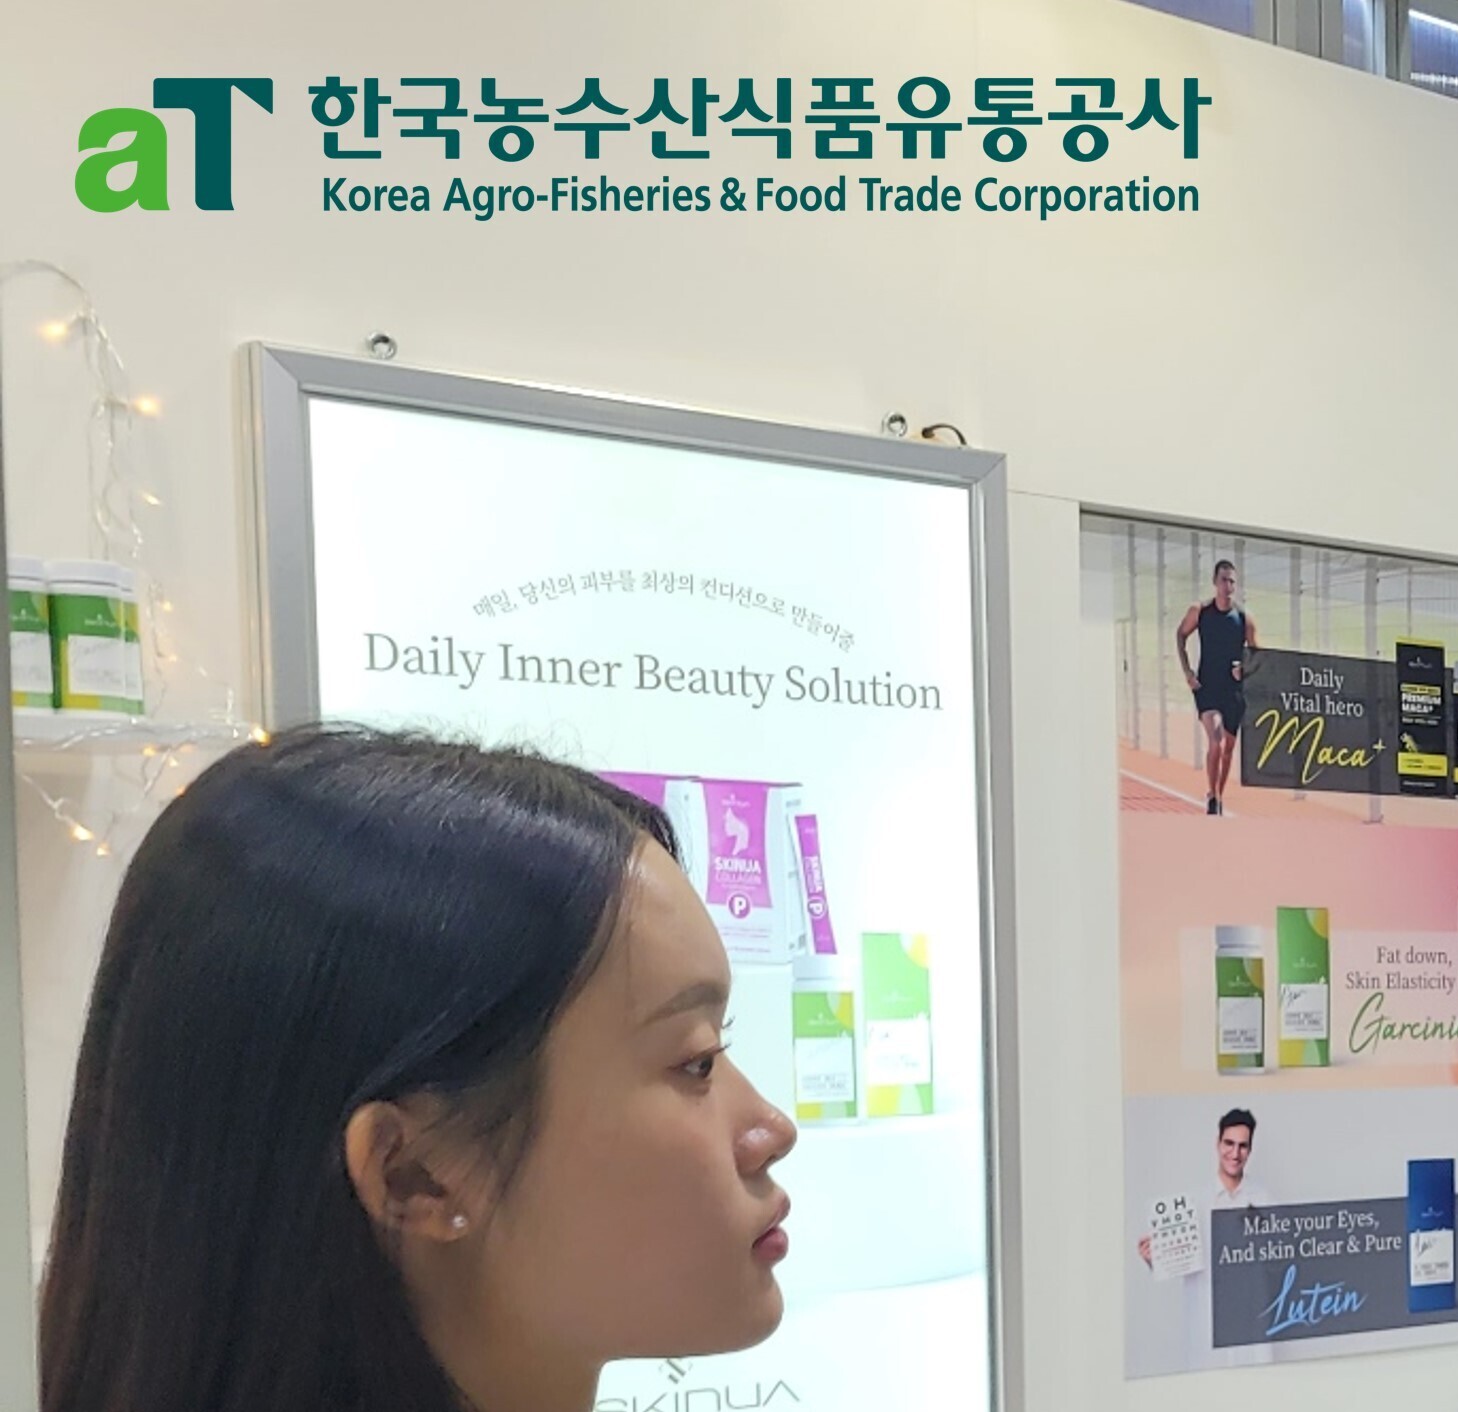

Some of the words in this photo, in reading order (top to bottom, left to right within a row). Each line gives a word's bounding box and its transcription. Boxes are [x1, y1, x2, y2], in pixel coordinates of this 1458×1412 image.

[472, 589, 518, 619] 매일,
[518, 574, 577, 605] 당신의
[580, 569, 637, 593] 피부를
[641, 570, 695, 595] 최상의
[700, 577, 786, 618] 컨디션으로
[790, 604, 857, 653] 만들어줄
[363, 631, 486, 687] Daily
[498, 643, 623, 689] Inner
[633, 654, 775, 710] Beauty
[785, 665, 944, 710] Solution
[1300, 667, 1344, 692] Daily
[1280, 692, 1321, 714] Vital
[1324, 694, 1364, 718] hero
[1376, 946, 1401, 965] Fat
[1404, 947, 1453, 968] down,
[1346, 971, 1382, 991] Skin
[1385, 971, 1456, 993] Elasticity
[1243, 1215, 1290, 1236] Make
[1294, 1213, 1335, 1235] your
[1337, 1210, 1381, 1232] Eyes,
[1219, 1244, 1253, 1265] And
[1257, 1240, 1297, 1260] skin
[1299, 1238, 1344, 1258] Clear
[1347, 1237, 1360, 1253] &
[1363, 1234, 1403, 1253] Pure
[1265, 1265, 1367, 1335] Lutein
